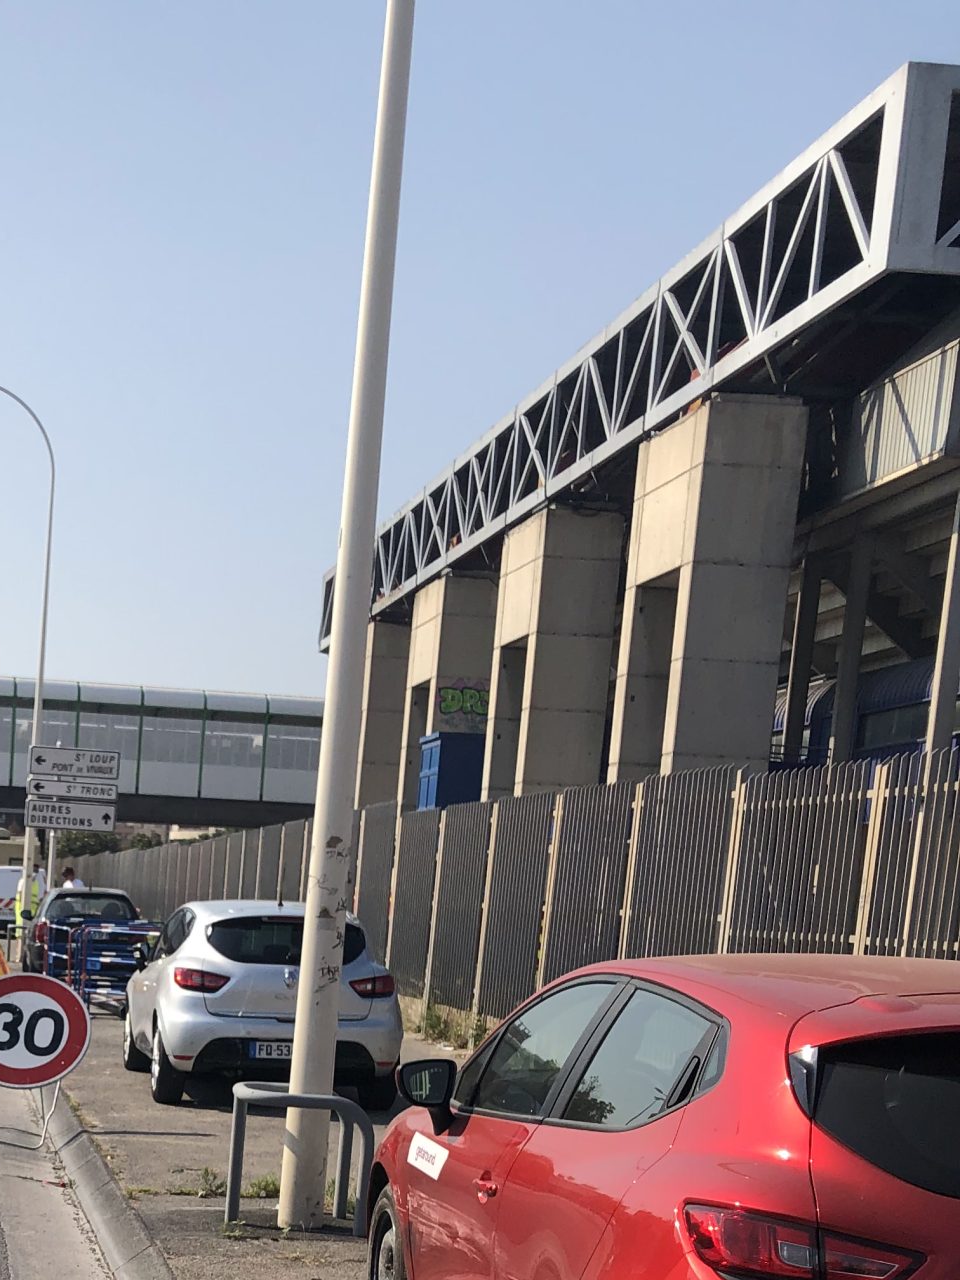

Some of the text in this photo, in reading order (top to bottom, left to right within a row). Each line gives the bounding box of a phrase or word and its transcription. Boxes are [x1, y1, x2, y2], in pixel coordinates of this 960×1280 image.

[90, 755, 115, 764] LOUP
[51, 763, 74, 772] PONT
[81, 786, 113, 796] TRONC
[31, 804, 71, 814] AUTRES
[30, 815, 93, 827] DIRECTIONS
